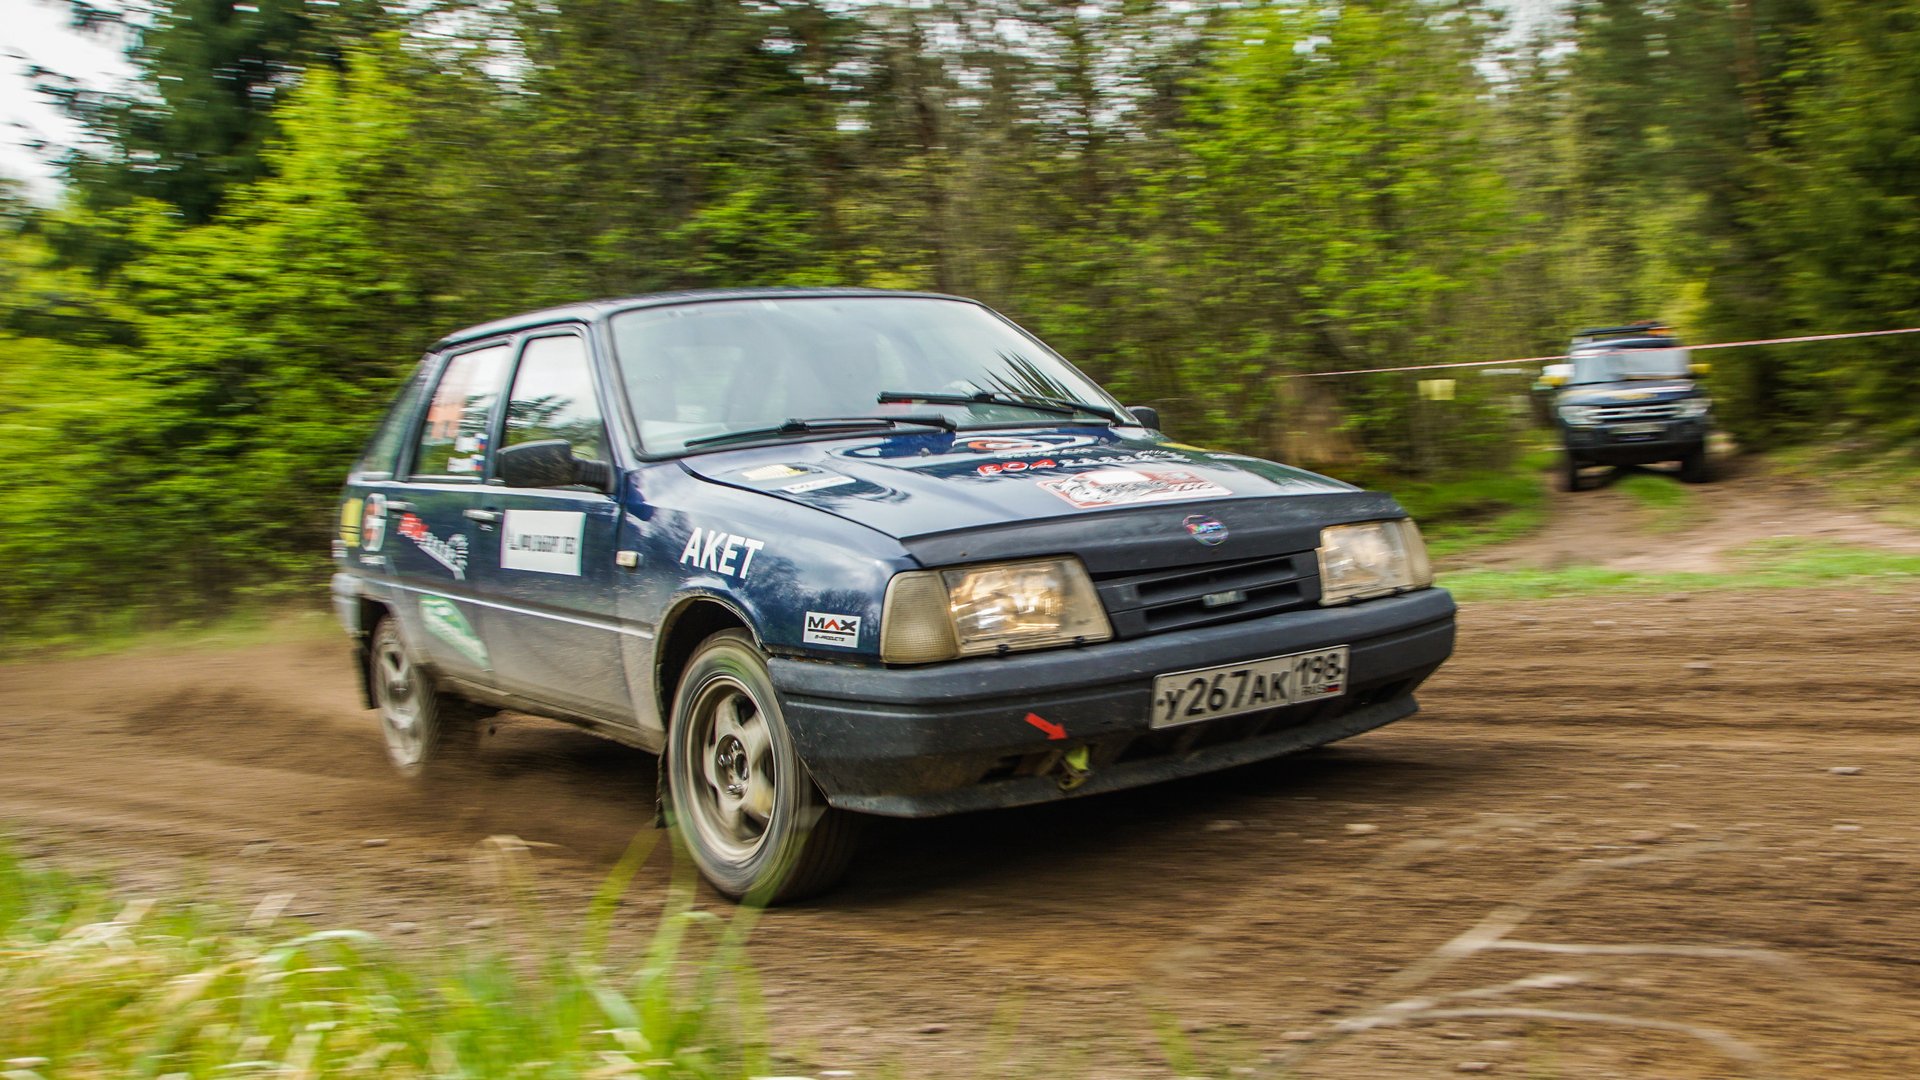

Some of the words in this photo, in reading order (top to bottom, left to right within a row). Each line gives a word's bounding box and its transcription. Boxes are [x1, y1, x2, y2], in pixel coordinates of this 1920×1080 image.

[680, 527, 764, 579] AKET
[808, 616, 856, 632] MAX
[1295, 653, 1341, 685] 198
